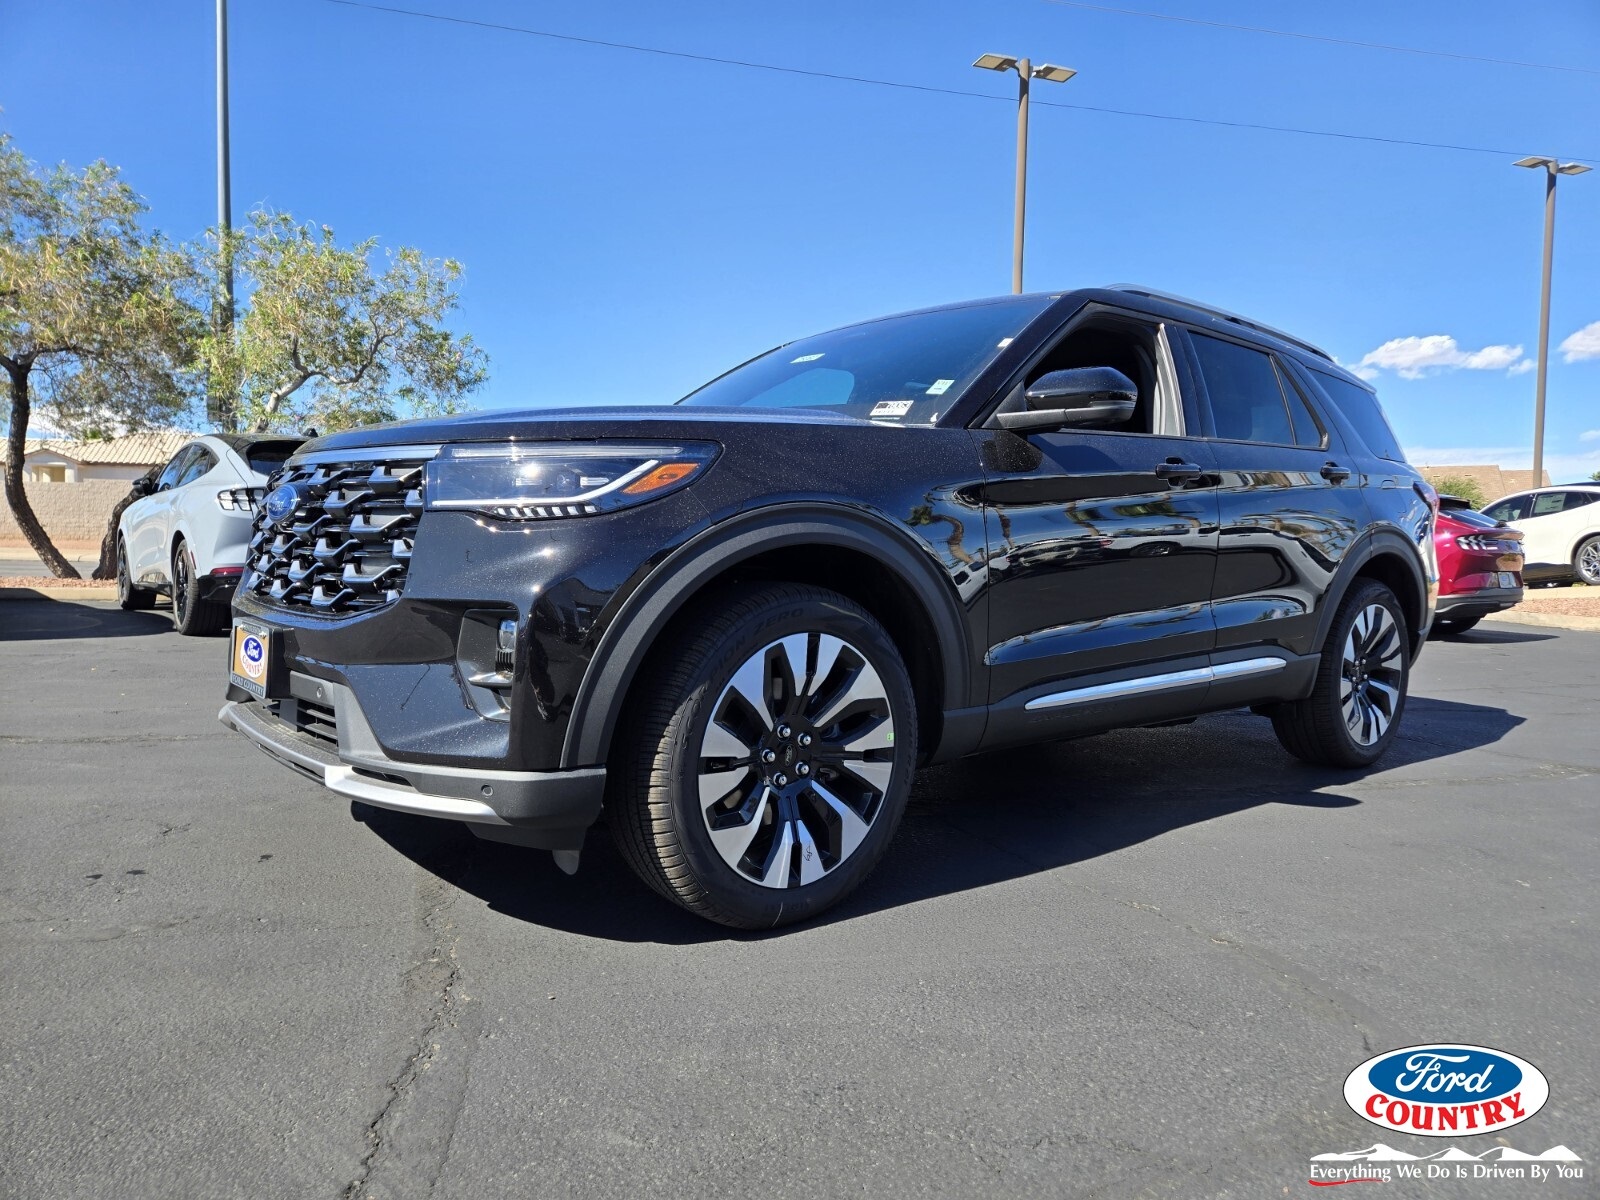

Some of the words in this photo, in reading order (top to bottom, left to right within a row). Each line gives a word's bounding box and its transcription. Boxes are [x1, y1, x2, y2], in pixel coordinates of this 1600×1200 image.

[754, 607, 804, 637] ZERO
[232, 674, 244, 686] FORD
[243, 679, 264, 696] COUNTRY
